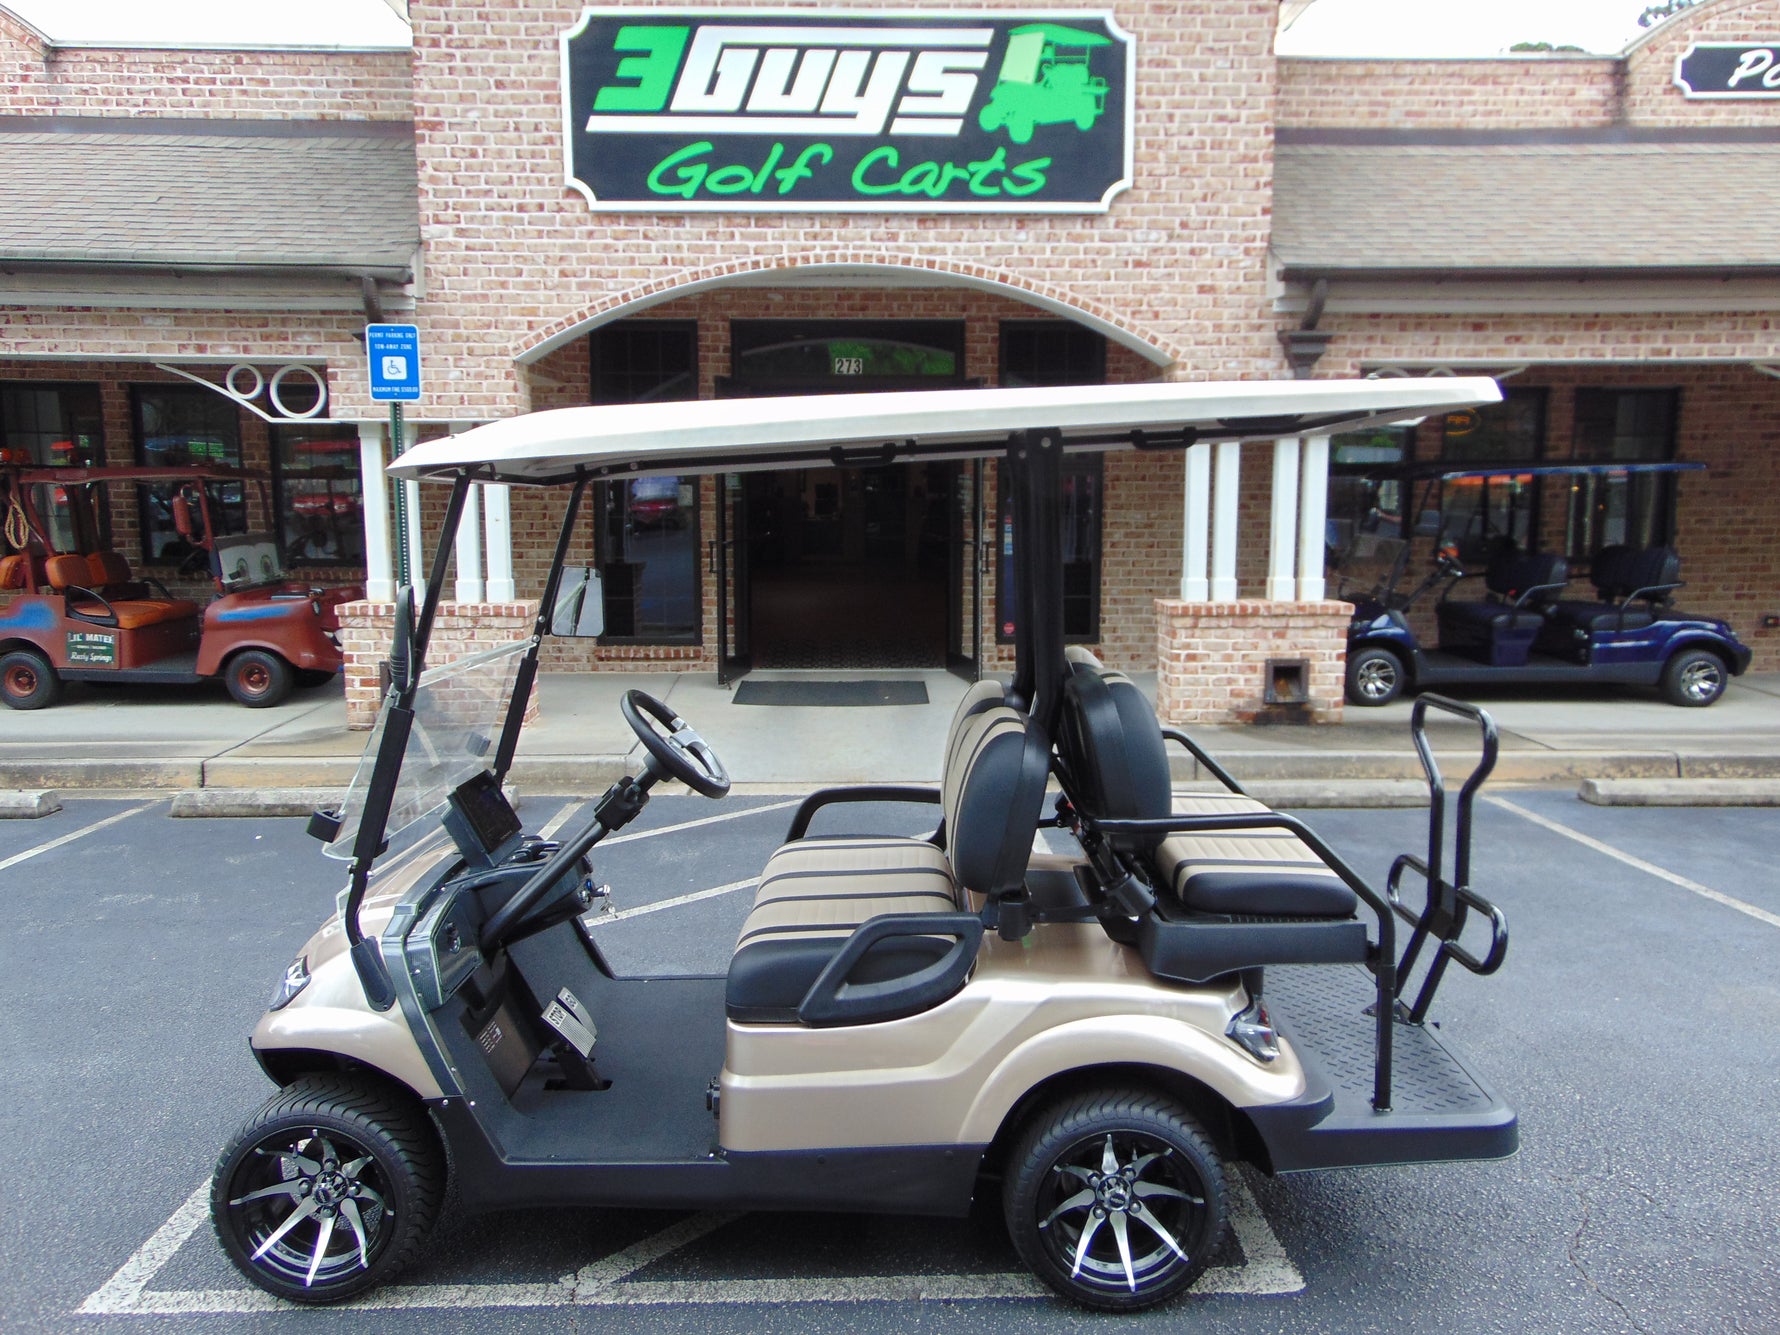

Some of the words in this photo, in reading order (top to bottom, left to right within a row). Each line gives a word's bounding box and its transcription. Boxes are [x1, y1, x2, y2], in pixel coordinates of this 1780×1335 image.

[647, 140, 834, 200] Golf
[851, 145, 1052, 198] Carts
[836, 358, 861, 374] 273
[549, 1007, 564, 1025] STOP
